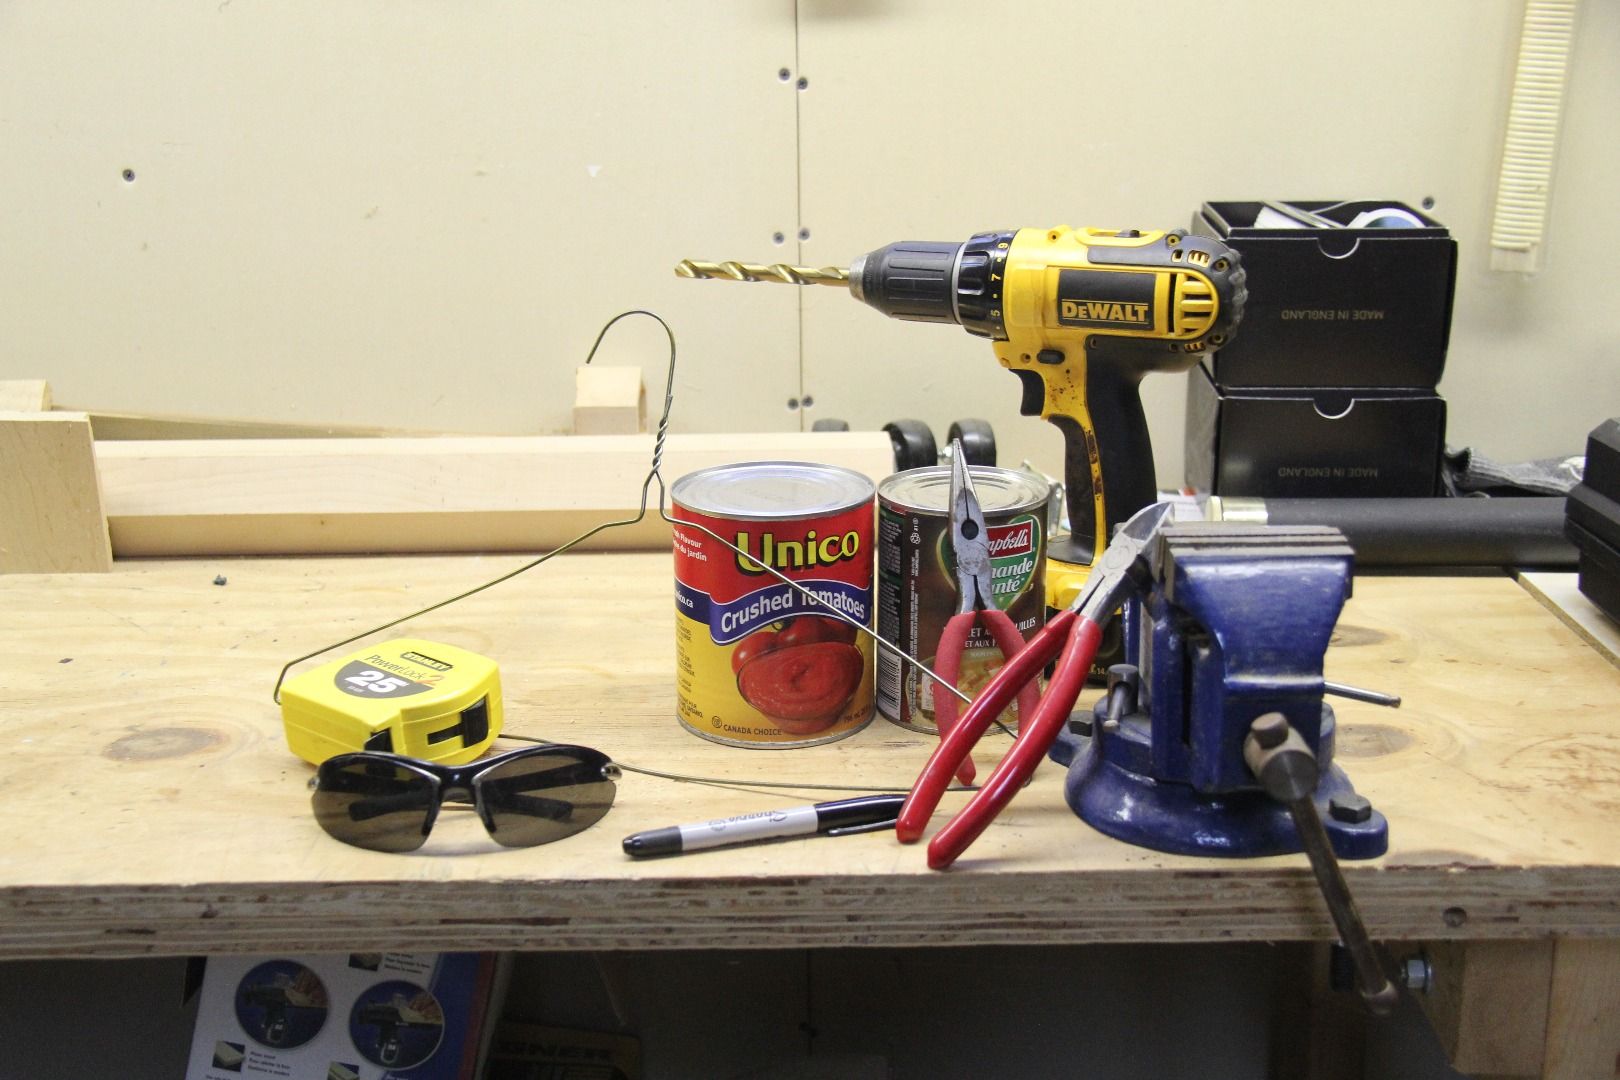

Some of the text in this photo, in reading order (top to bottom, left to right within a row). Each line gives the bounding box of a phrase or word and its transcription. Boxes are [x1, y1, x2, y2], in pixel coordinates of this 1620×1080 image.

[991, 273, 1001, 282] 7
[1280, 309, 1385, 320] MADE IN ENGLAND
[1277, 466, 1379, 478] MADE IN ENGLAND
[680, 533, 703, 549] Flavour
[687, 547, 708, 562] jardin
[736, 529, 861, 575] Unico
[992, 575, 1021, 595] nté
[720, 587, 794, 634] Crushed
[800, 586, 866, 620] Tomatoes
[344, 670, 410, 693] 25
[723, 724, 783, 736] CANADA CHOICE
